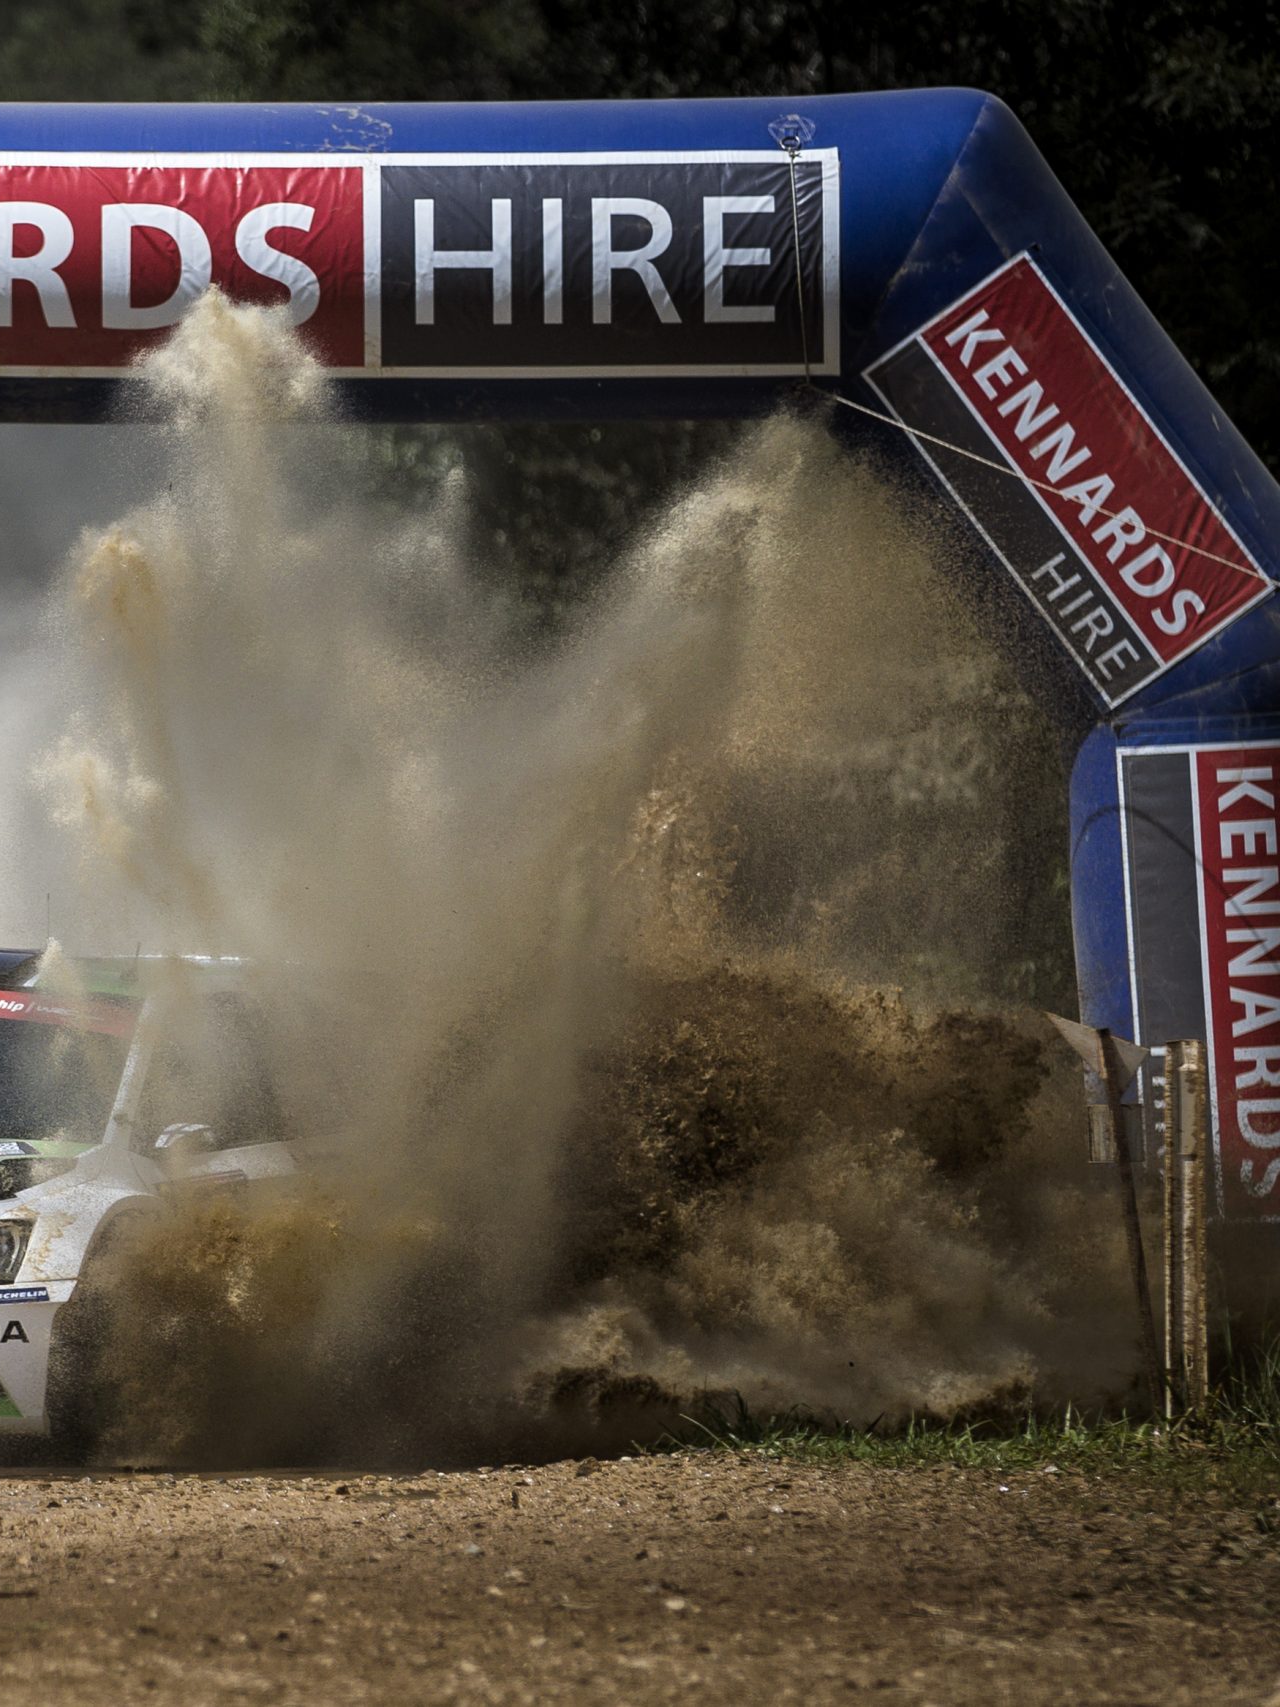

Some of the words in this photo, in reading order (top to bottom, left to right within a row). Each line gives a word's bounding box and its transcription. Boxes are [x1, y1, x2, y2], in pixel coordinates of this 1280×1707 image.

[414, 195, 776, 325] HIRE
[945, 308, 1206, 636] KENNARDS
[1030, 552, 1140, 681] HIRE
